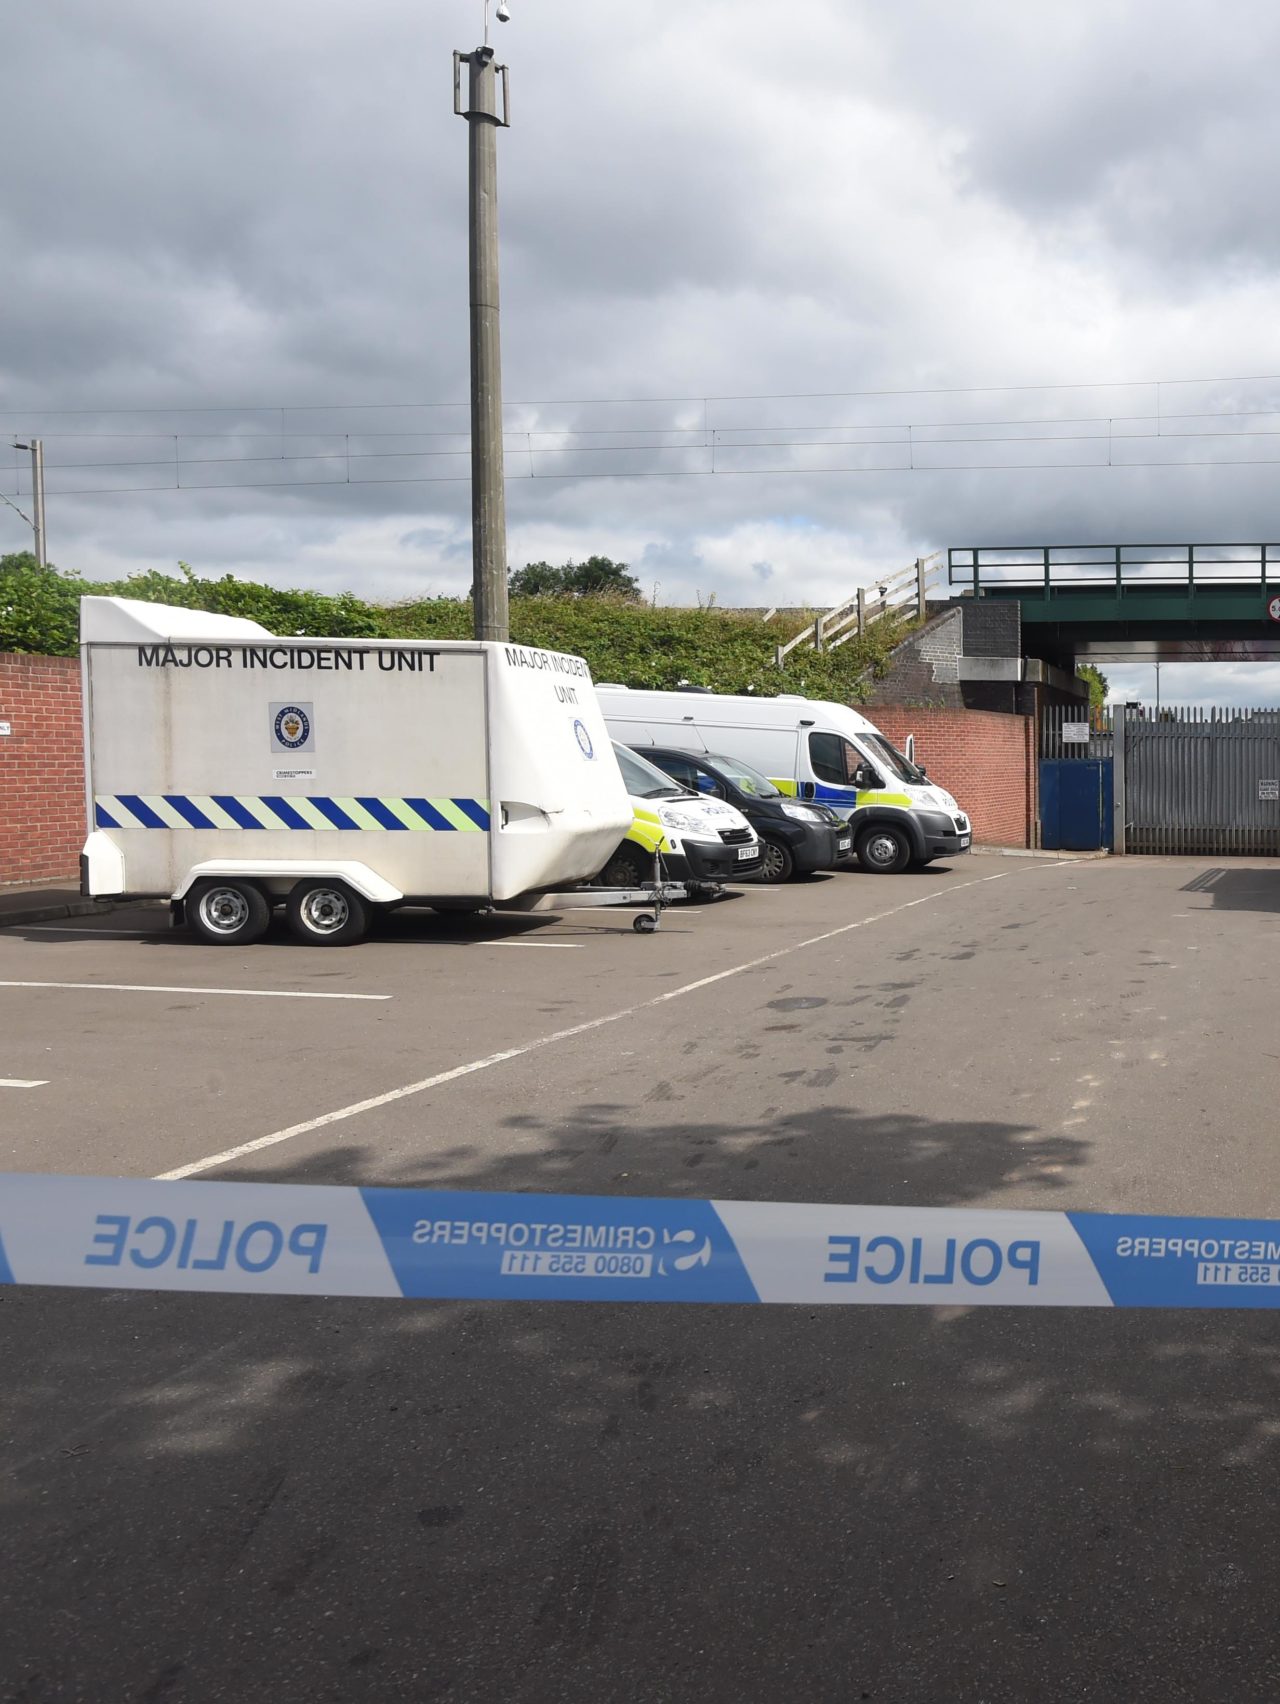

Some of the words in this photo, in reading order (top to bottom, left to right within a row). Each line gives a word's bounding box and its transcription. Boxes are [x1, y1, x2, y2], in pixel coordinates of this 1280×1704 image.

[138, 645, 233, 668] MAJOR
[242, 647, 370, 671] INCIDENT
[378, 650, 440, 672] UNIT
[505, 647, 551, 671] MAJOR
[554, 685, 579, 704] UNIT
